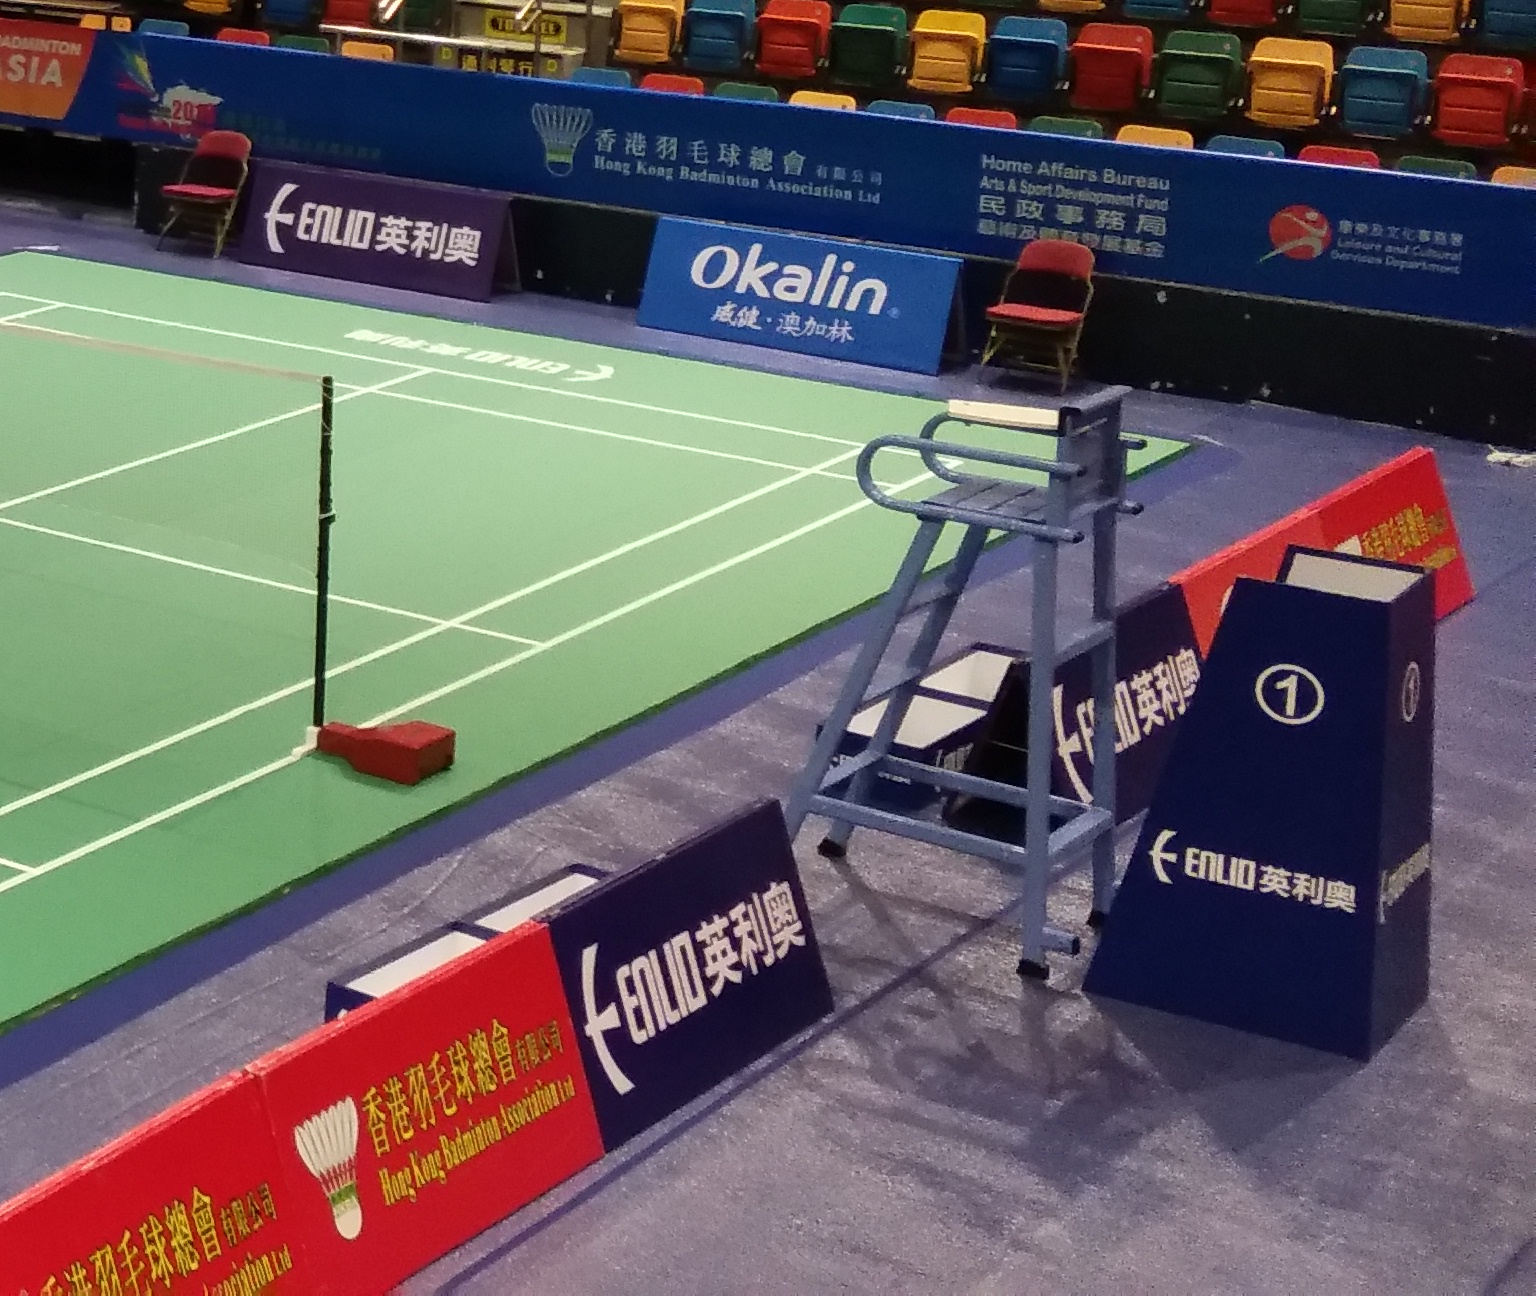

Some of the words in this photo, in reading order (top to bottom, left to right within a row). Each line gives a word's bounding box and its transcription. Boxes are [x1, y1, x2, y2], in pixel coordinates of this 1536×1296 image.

[595, 128, 807, 177] 香港羽毛球總會
[982, 154, 1033, 174] Home
[1037, 161, 1097, 183] Affairs
[1103, 168, 1170, 191] Bureau
[594, 154, 632, 176] Hong
[636, 161, 674, 182] Kong
[679, 167, 759, 190] Badminton
[766, 178, 853, 202] Association
[858, 189, 881, 205] Ltd
[980, 175, 1005, 192] Arts
[1007, 178, 1017, 193] &
[1019, 179, 1053, 198] Sport
[1055, 184, 1135, 208] Development
[1137, 194, 1169, 212] Fund
[297, 202, 376, 249] ENLIO
[979, 194, 1167, 237] 民政事務局
[690, 242, 889, 315] Okalin
[1184, 847, 1256, 891] ENLIO
[616, 930, 709, 1045] ENLIO
[362, 1018, 517, 1158] 香港羽毛球總會
[379, 1168, 418, 1205] Hong
[409, 1151, 447, 1184] Kong
[439, 1115, 501, 1170] Badminton
[500, 1079, 561, 1135] Association
